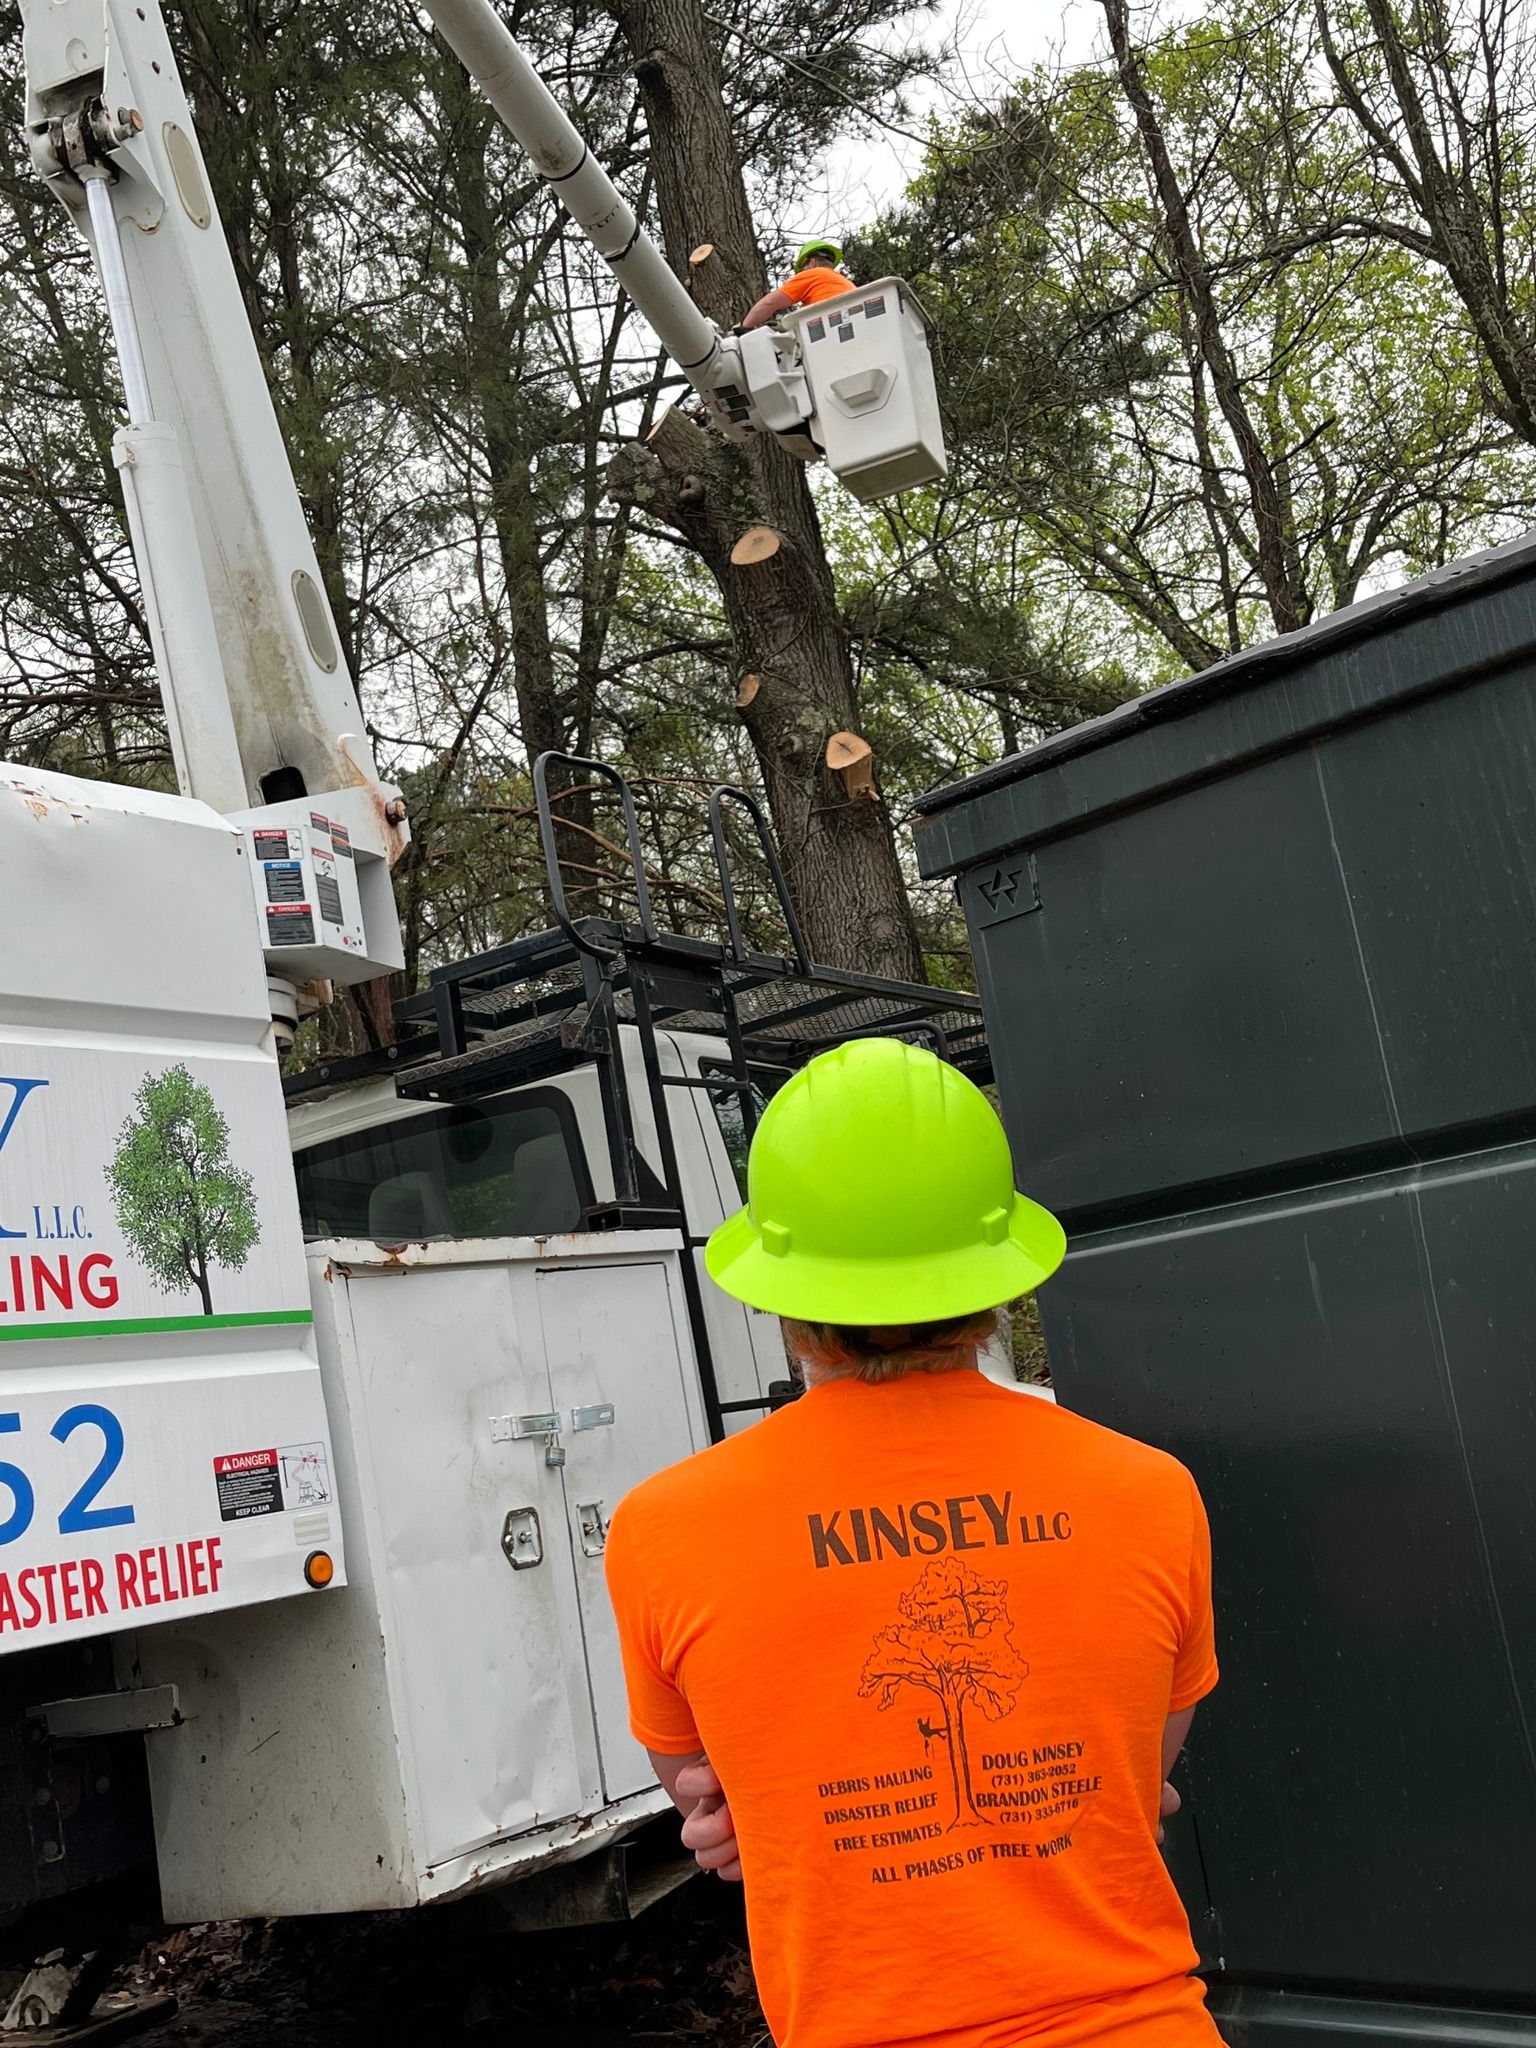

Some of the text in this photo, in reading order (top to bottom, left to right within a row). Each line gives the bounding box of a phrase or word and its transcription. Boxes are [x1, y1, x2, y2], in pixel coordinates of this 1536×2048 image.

[32, 1205, 93, 1239] L.L.C.
[0, 1253, 119, 1313] ING
[232, 1453, 271, 1469] DANGER
[236, 1505, 270, 1516] KEEP CLEAR
[808, 1491, 1071, 1569] KINSEY LLC
[115, 1537, 223, 1610] RELIEF
[982, 1741, 1085, 1771] DOUG KINSEY
[818, 1765, 933, 1798] DEBRIS HAULING
[976, 1776, 1103, 1807] BRANDON STEELE
[991, 1773, 1024, 1789] (731)
[824, 1792, 938, 1824] DISASTER RELIEF
[1000, 1810, 1032, 1825] (731)
[833, 1822, 942, 1852] FREE ESTIMATES
[872, 1832, 1072, 1883] ALL PHASES OF TREE WORK
